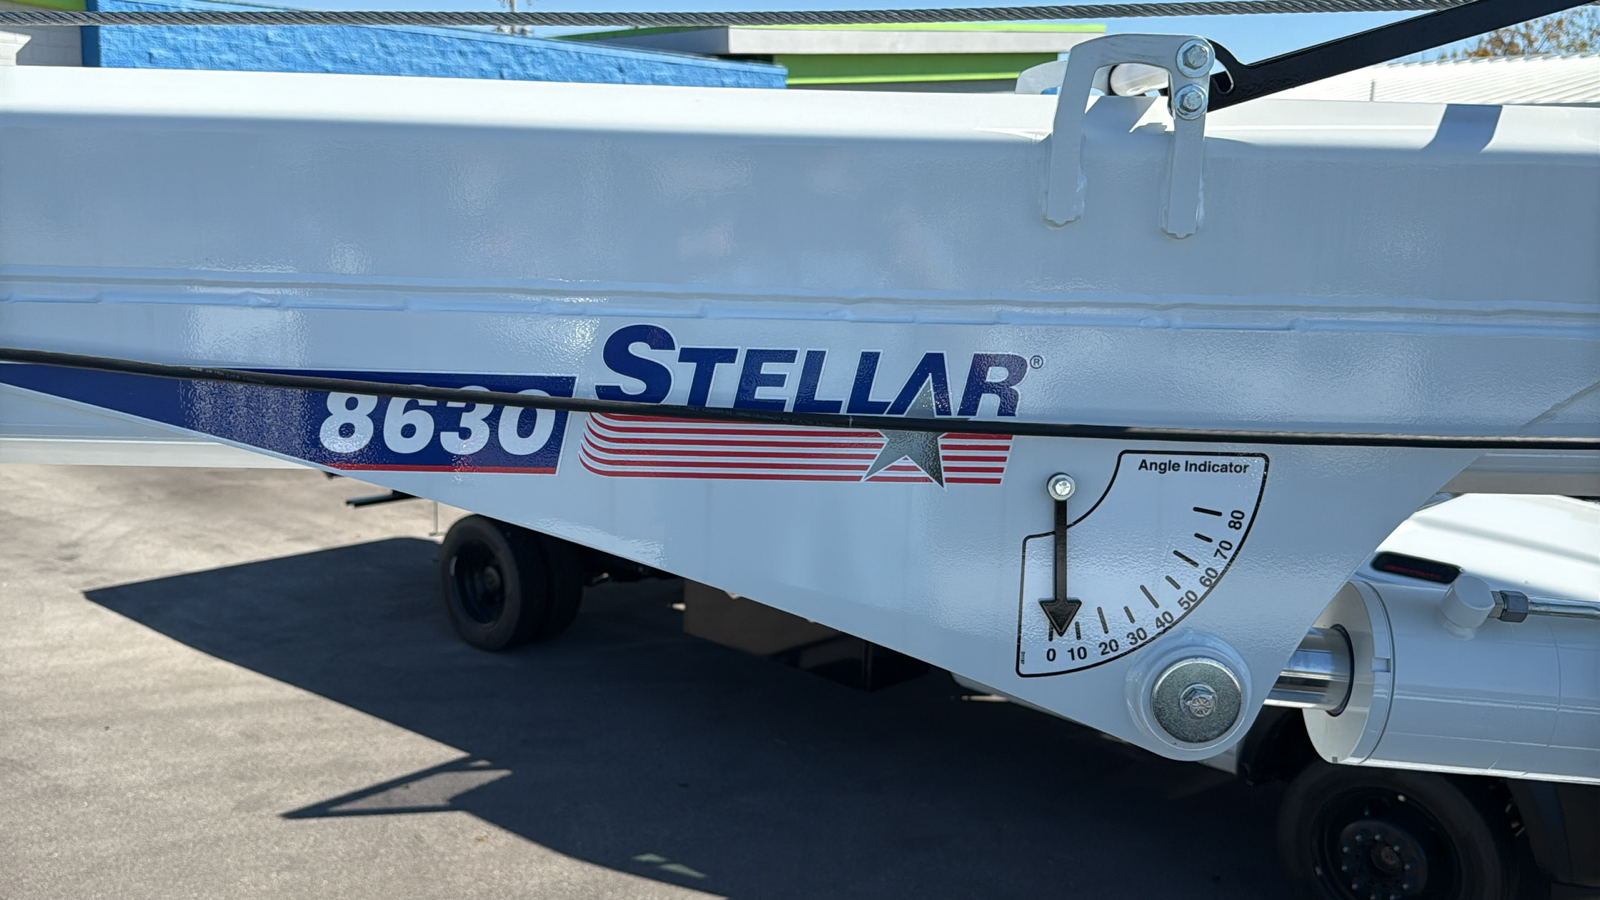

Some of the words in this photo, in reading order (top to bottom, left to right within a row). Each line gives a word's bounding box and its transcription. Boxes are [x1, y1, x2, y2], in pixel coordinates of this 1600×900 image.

[319, 384, 556, 455] 8630
[1138, 459, 1180, 474] Angle
[1185, 460, 1249, 474] Indicator
[1046, 648, 1057, 662] 0
[1067, 646, 1087, 660] 10
[1098, 639, 1119, 655] 20
[1127, 628, 1148, 646] 30
[1155, 611, 1175, 630] 40
[1177, 589, 1198, 611] 50
[1199, 567, 1218, 588] 60
[1214, 540, 1233, 560] 70
[1228, 509, 1246, 531] 80
